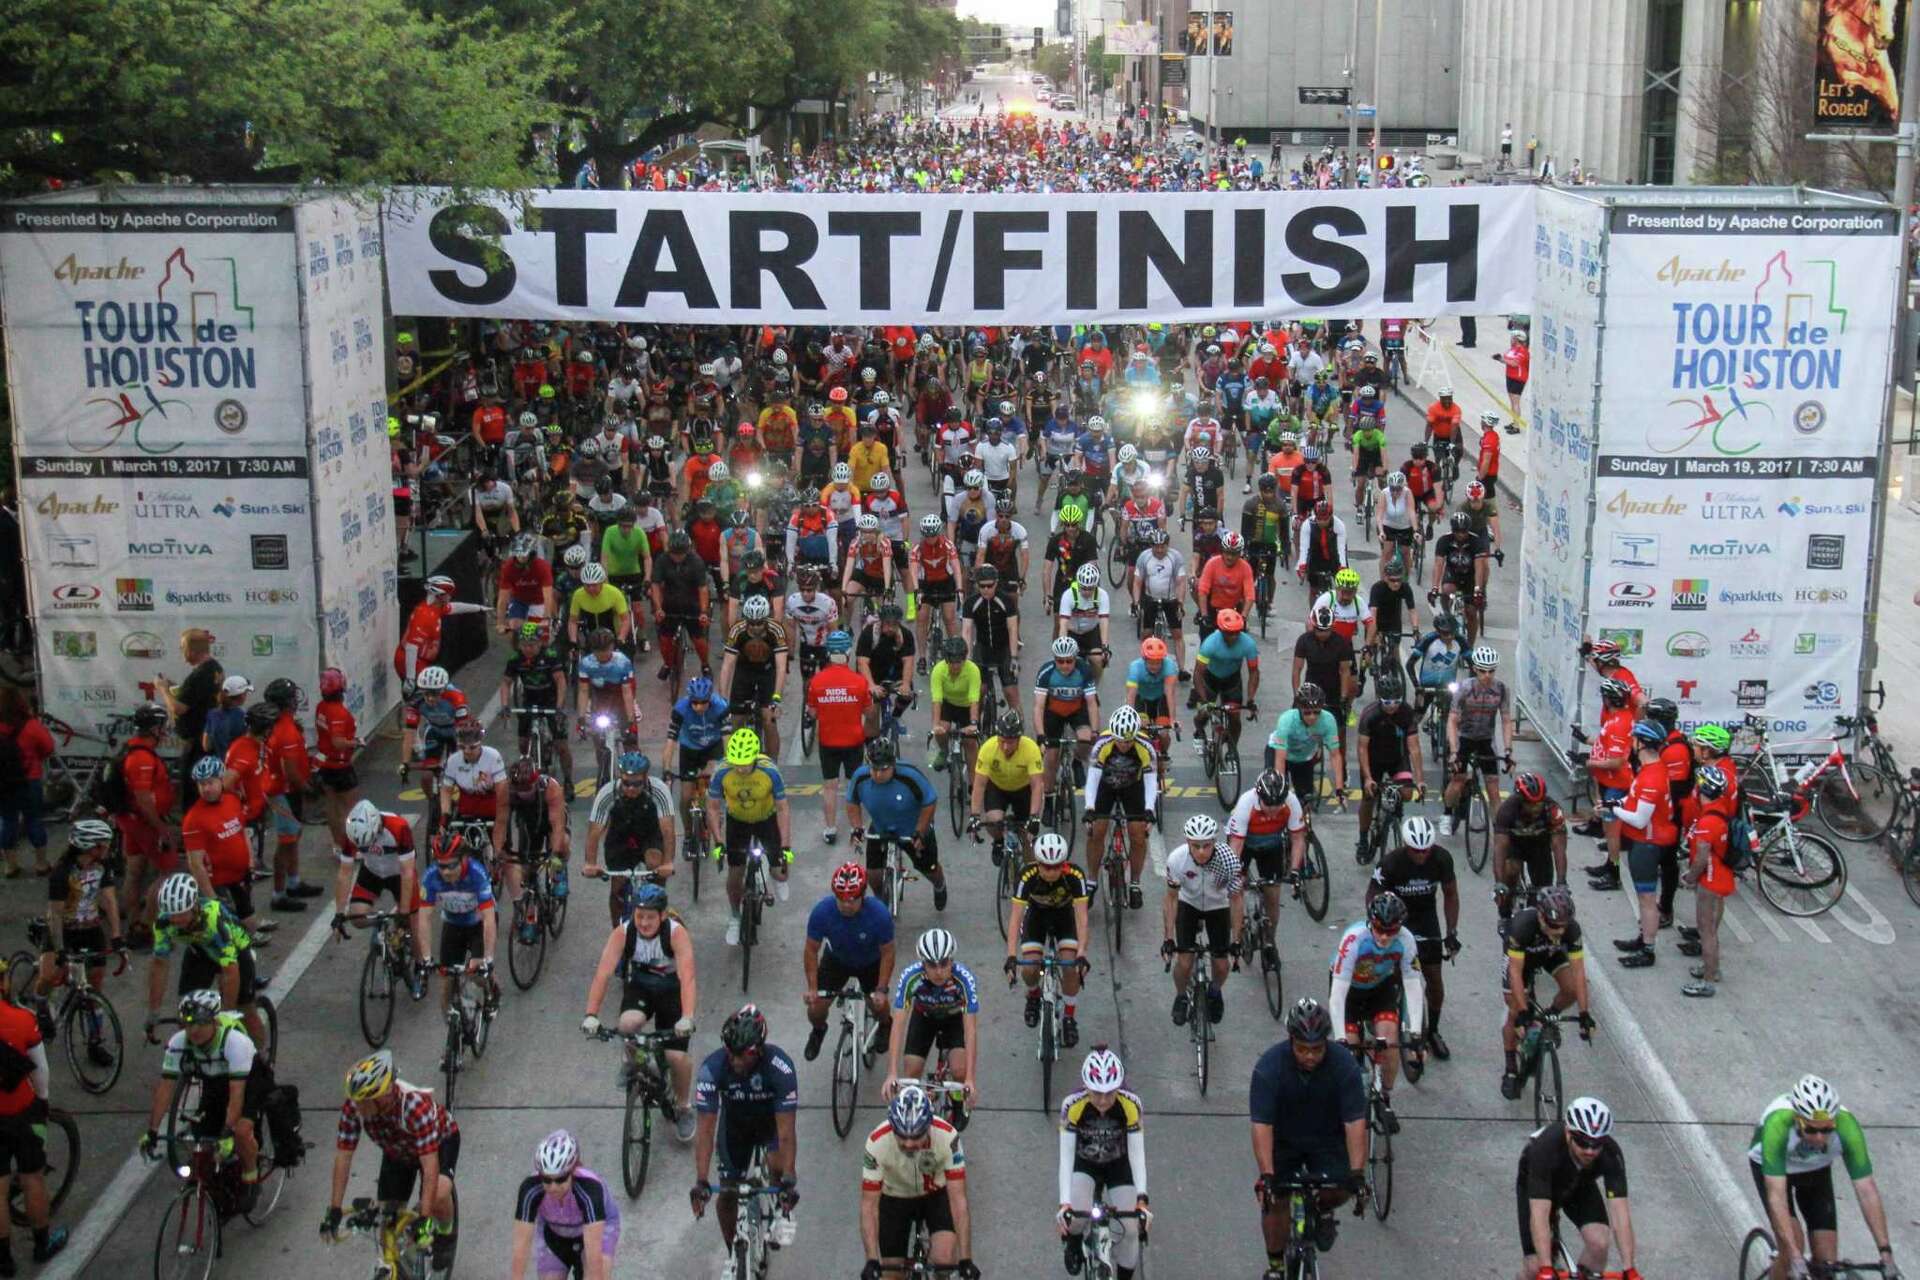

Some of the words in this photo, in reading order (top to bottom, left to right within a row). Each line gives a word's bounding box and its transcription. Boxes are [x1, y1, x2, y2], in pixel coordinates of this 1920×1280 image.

[15, 212, 97, 226] Presented
[100, 212, 117, 229] by
[123, 213, 181, 229] Apache
[185, 213, 278, 229] Corporation
[1627, 214, 1704, 229] Presented
[1707, 214, 1726, 232] by
[1729, 215, 1788, 232] Apache
[1791, 215, 1883, 232] Corporation
[428, 204, 1480, 313] START/FINISH
[54, 252, 146, 285] Apache
[1657, 255, 1746, 287] Apache
[75, 301, 182, 344] TOUR
[196, 319, 238, 344] de
[1672, 303, 1772, 346] TOUR
[1787, 321, 1829, 345] de
[85, 347, 257, 389] HOUSTON
[1672, 349, 1842, 390] HOUSTON
[36, 459, 92, 476] Sunday
[112, 459, 157, 473] March
[161, 460, 183, 475] 19,
[186, 459, 221, 473] 2017
[238, 460, 269, 473] 7:30
[272, 460, 296, 473] AM
[1611, 458, 1667, 476] Sunday
[1685, 459, 1729, 474] March
[1733, 460, 1755, 475] 19,
[1758, 460, 1792, 474] 2017
[1810, 460, 1838, 474] 7:30
[1841, 460, 1864, 473] AM
[37, 491, 120, 520] Apache
[135, 503, 200, 520] ULTRA
[1606, 489, 1688, 518] Apache
[1701, 505, 1766, 520] ULTRA
[128, 538, 213, 556] MOTIVA
[1690, 539, 1771, 556] MOTIVA
[117, 591, 154, 604] KIND
[172, 590, 232, 606] Sparkletts
[1608, 600, 1655, 608] LIBERTY
[1672, 591, 1709, 605] KIND
[1726, 589, 1782, 605] Sparkletts
[825, 688, 849, 697] RIDE
